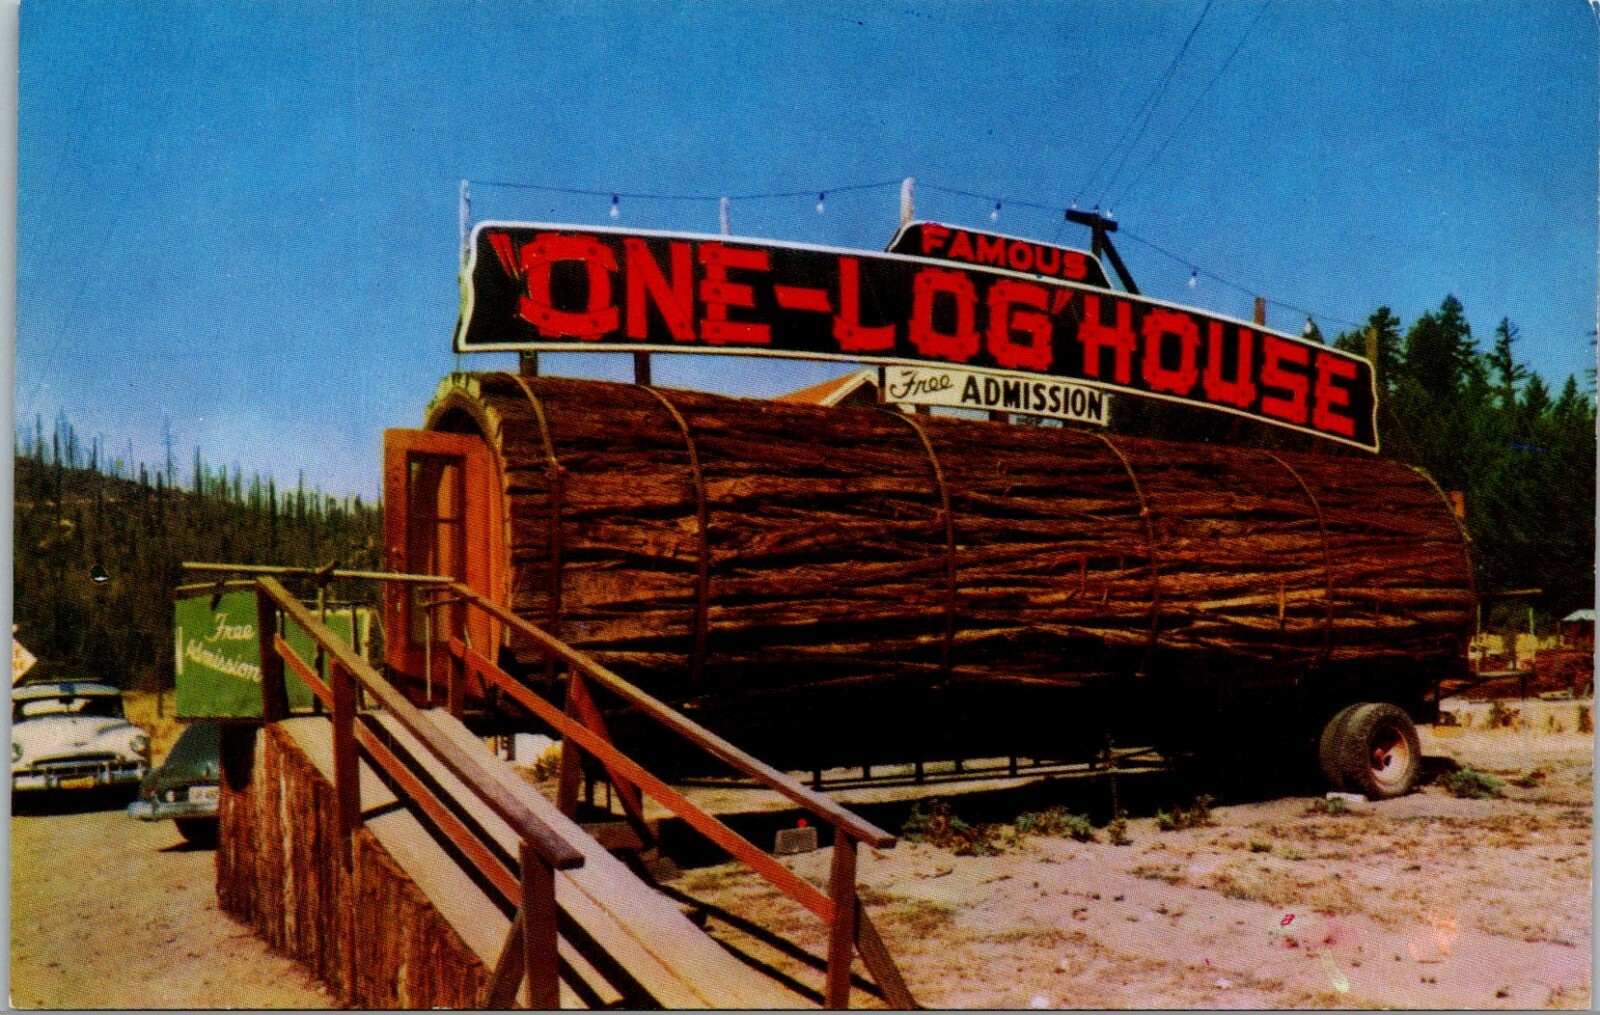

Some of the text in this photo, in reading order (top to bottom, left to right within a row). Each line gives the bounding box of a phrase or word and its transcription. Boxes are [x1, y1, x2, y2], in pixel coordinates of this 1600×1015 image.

[921, 222, 1088, 280] FAMOUS
[889, 366, 1103, 421] Free ADMISSION
[1078, 294, 1357, 438] HOUSE
[203, 611, 256, 642] Free
